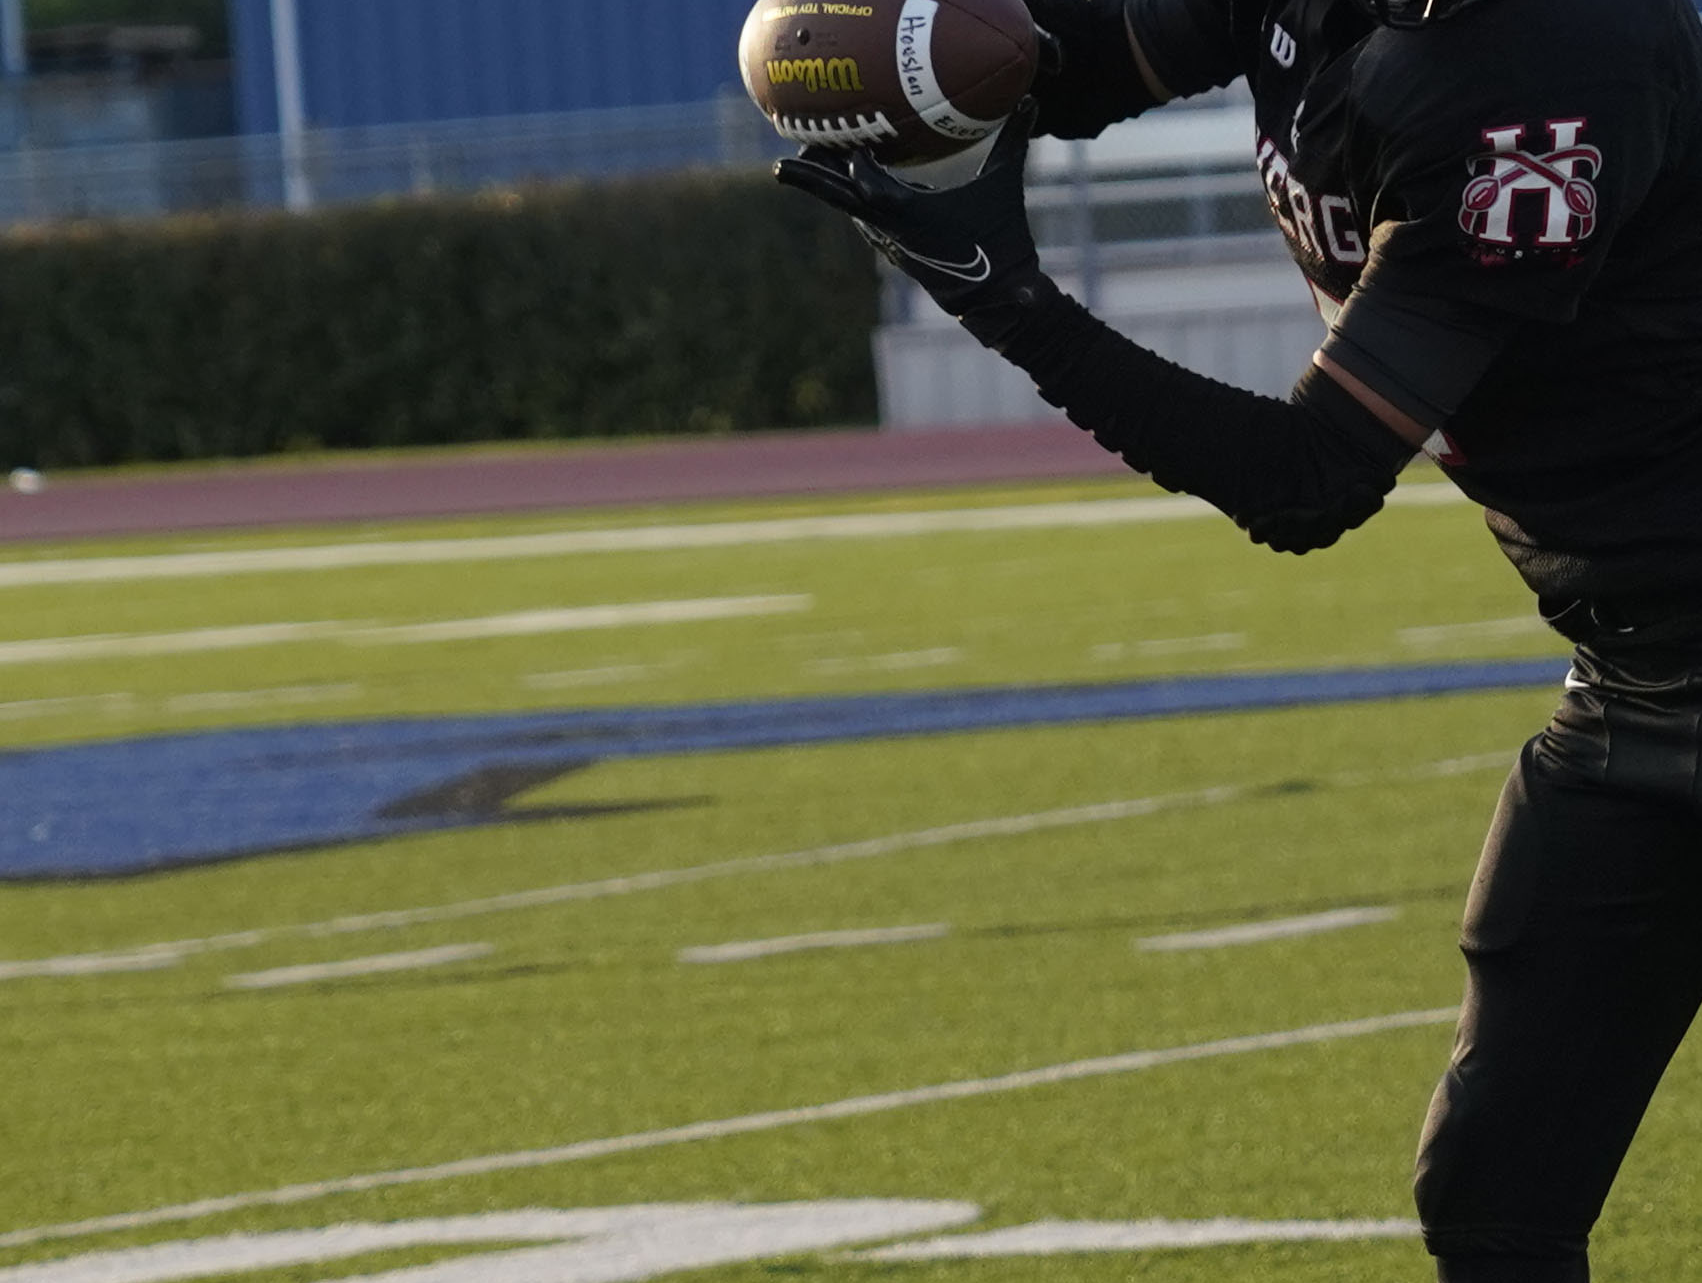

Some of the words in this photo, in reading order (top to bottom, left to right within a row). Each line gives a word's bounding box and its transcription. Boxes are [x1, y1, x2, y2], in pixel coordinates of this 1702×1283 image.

[822, 3, 873, 17] OFFICIAL
[766, 57, 864, 93] Wilson
[1477, 117, 1588, 246] H
